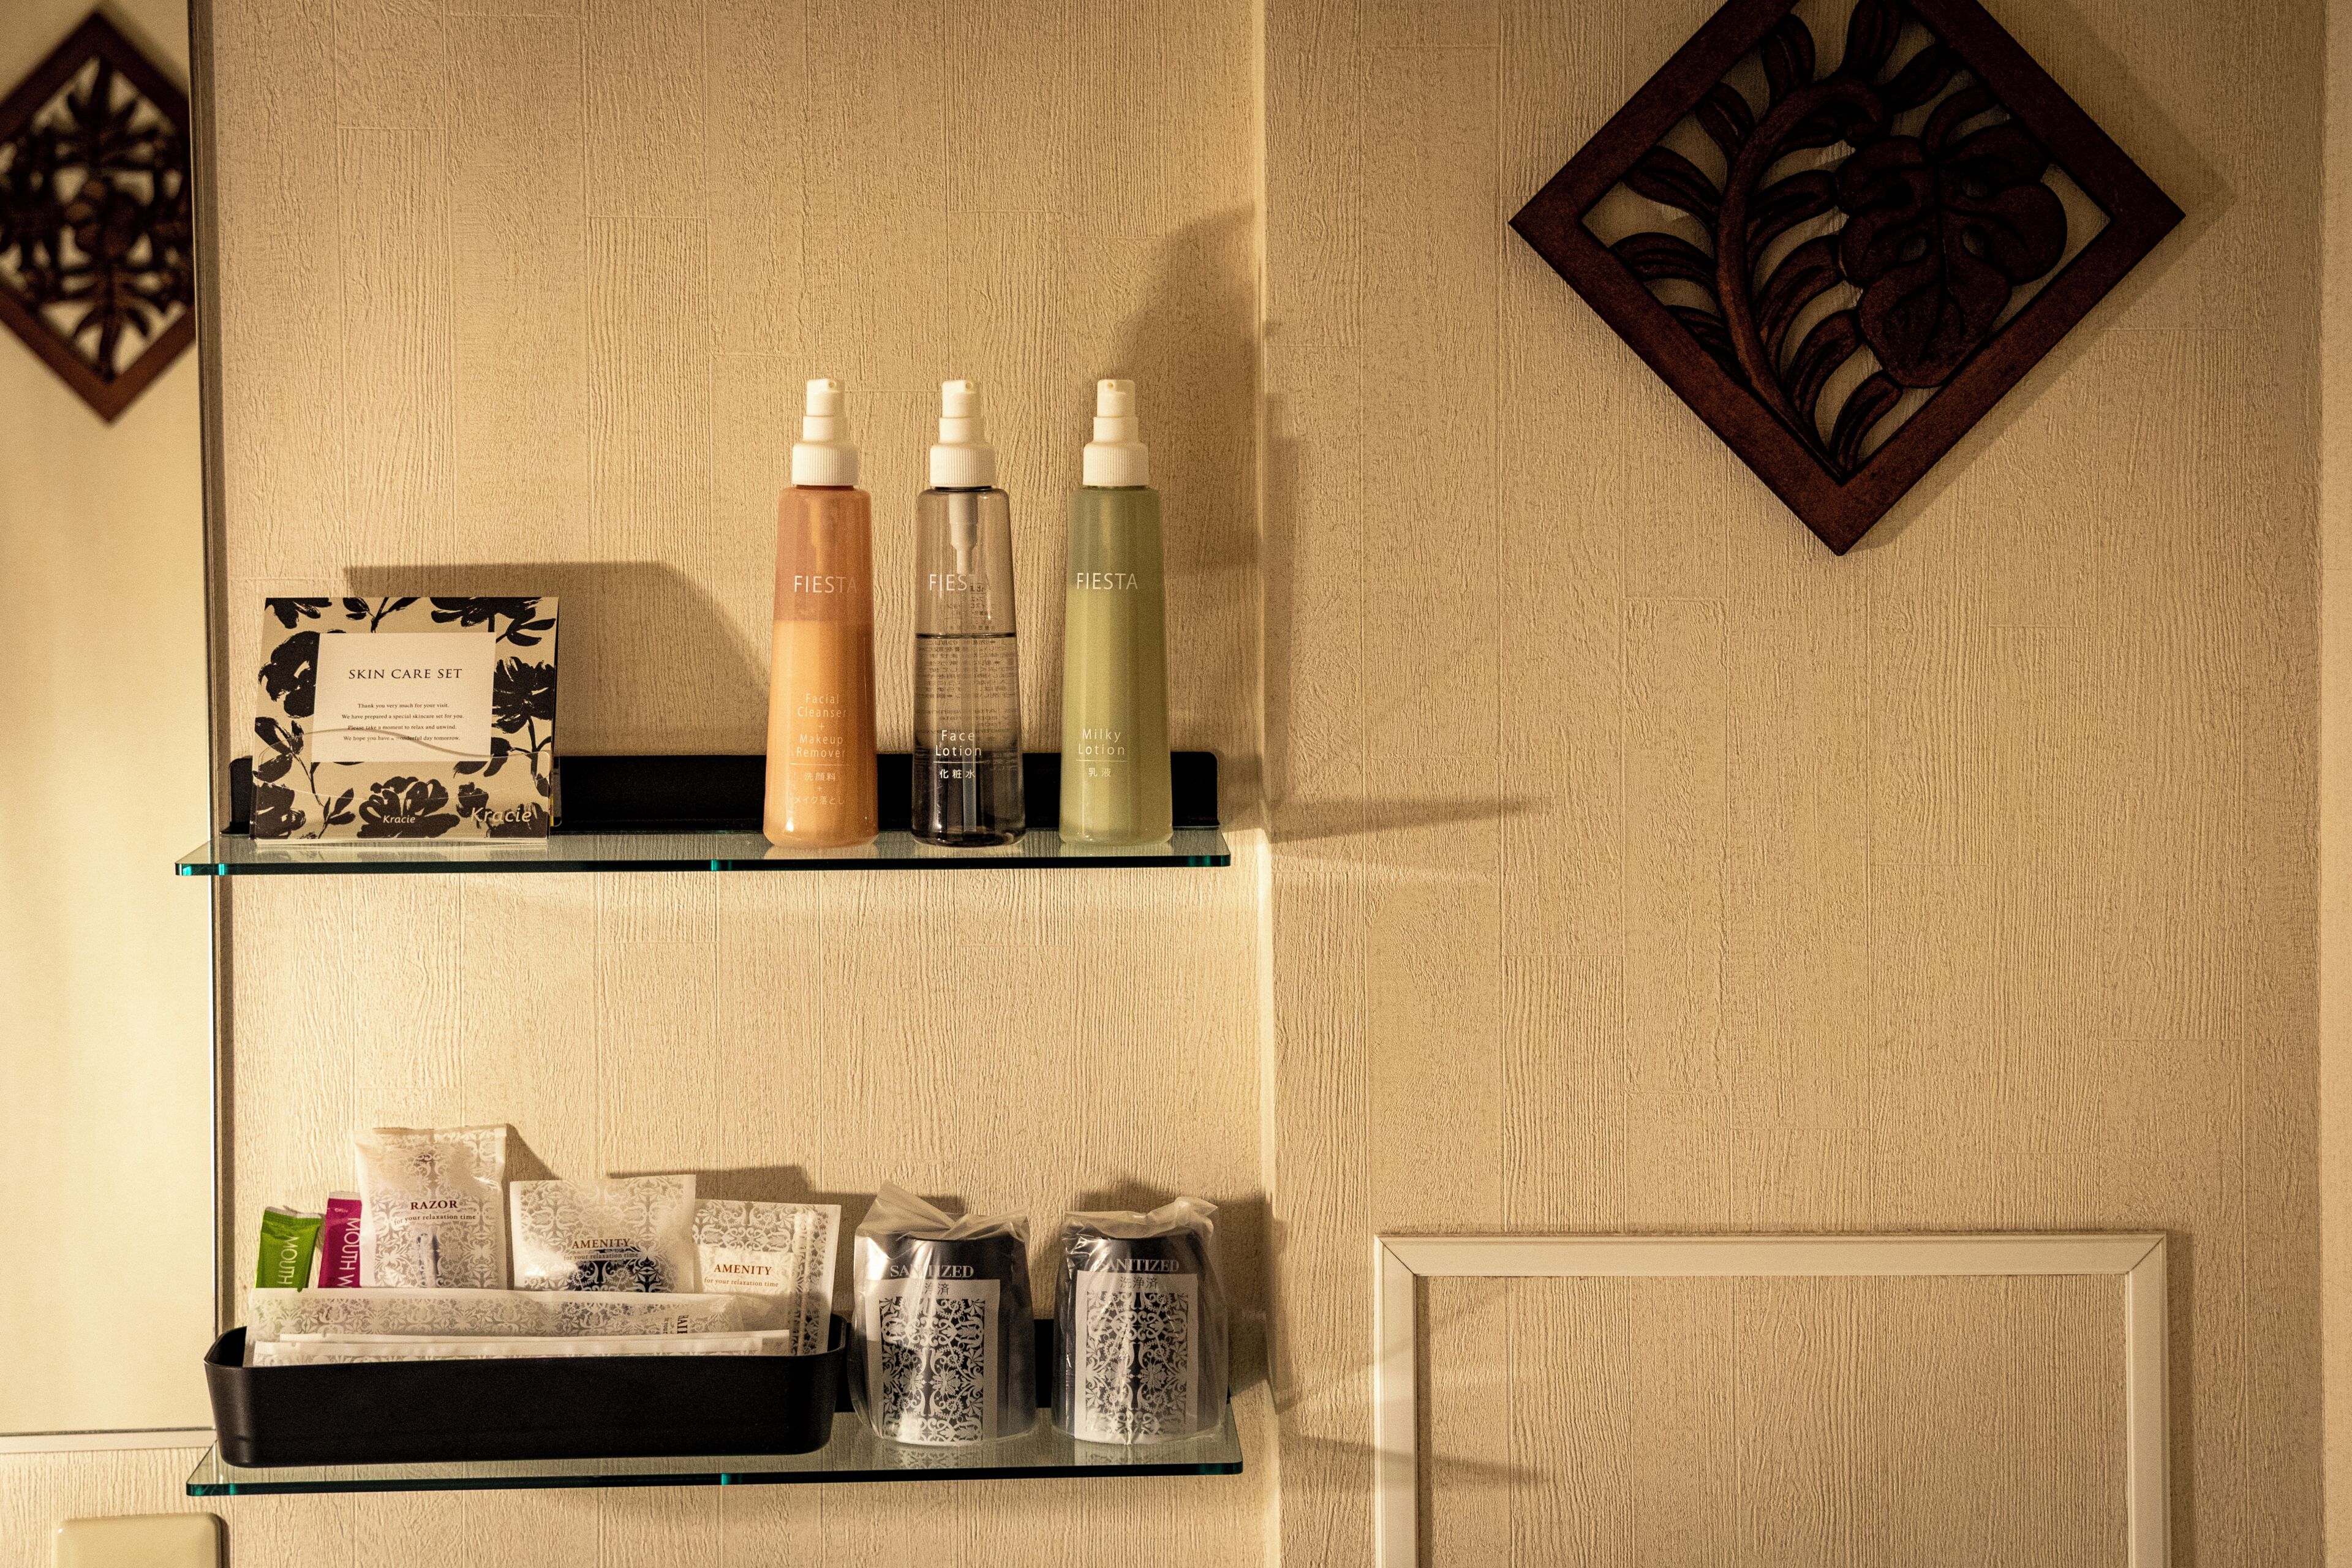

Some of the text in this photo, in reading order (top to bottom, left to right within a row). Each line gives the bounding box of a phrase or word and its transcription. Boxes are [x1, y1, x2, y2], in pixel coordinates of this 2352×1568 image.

[794, 576, 858, 594] FIESTA
[1077, 573, 1138, 590] FIESTA
[349, 668, 462, 679] SKIN CARE SET
[805, 693, 839, 704] Facial
[797, 706, 846, 717] Cleanser
[799, 734, 843, 746] Makeup
[941, 729, 975, 741] Face
[1082, 728, 1121, 743] Milky
[796, 747, 845, 758] Remover
[935, 745, 982, 756] Lotion
[1079, 743, 1125, 755] Lotion
[804, 772, 835, 782] 洗顔料
[939, 769, 975, 778] 化粧水
[1088, 767, 1111, 777] 乳液
[794, 796, 845, 805] メイク落とし
[470, 807, 532, 822] Kracie
[410, 1200, 458, 1210] RAZOR
[339, 1218, 361, 1270] MOUTH
[571, 1238, 631, 1249] AMENITY
[277, 1235, 300, 1284] MOUTH
[714, 1264, 772, 1275] AMENITY
